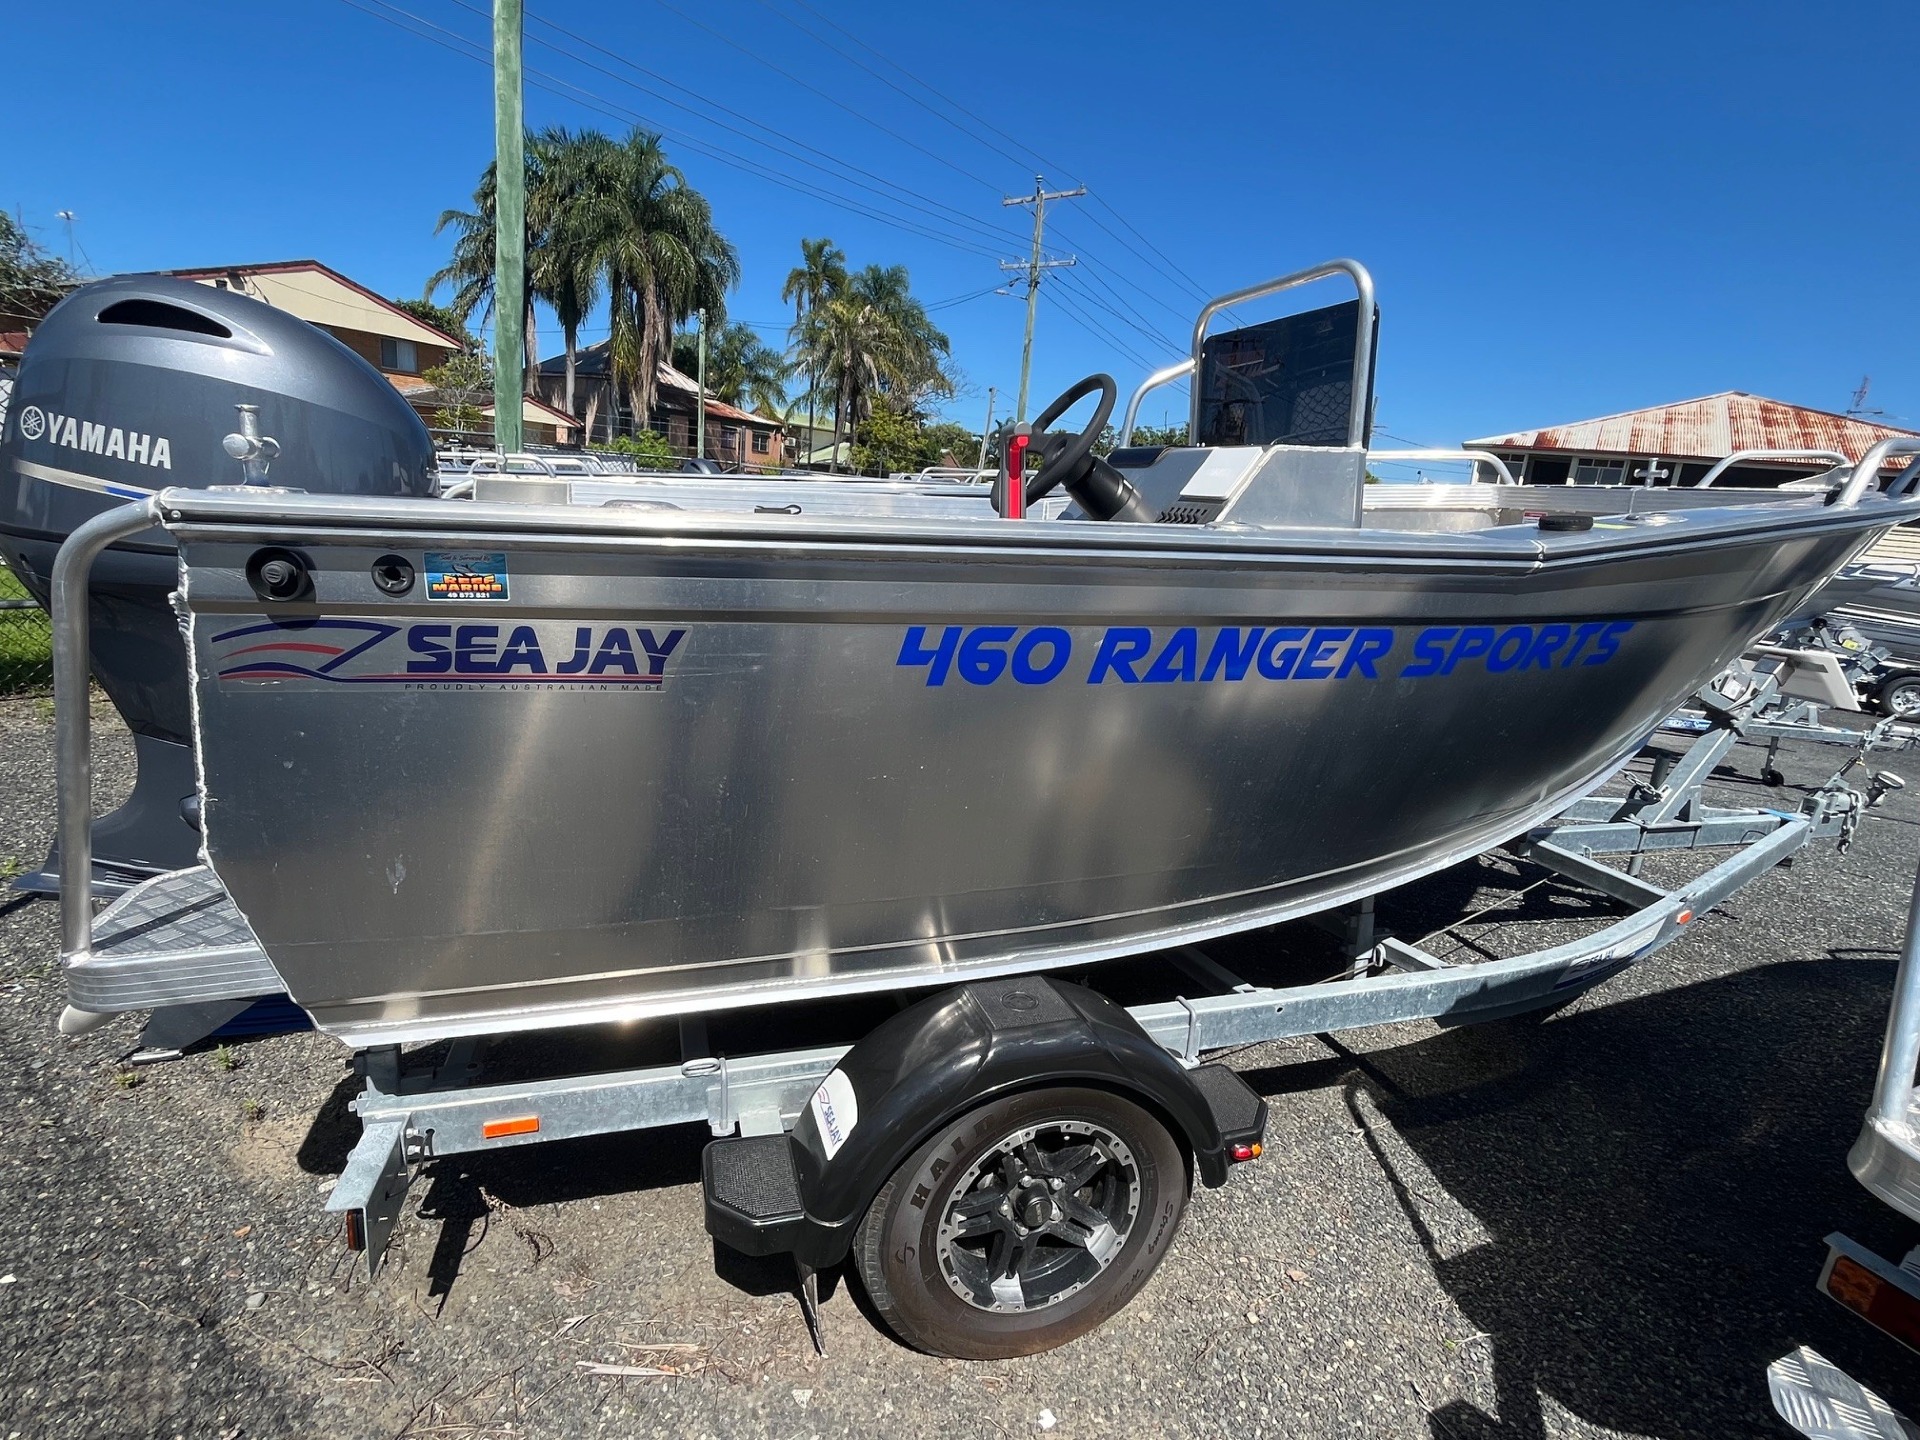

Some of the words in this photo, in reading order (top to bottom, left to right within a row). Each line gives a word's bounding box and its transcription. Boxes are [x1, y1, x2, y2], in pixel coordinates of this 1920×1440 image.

[48, 412, 172, 470] YAMAHA
[432, 583, 503, 592] MARINE
[443, 574, 496, 584] REEF
[406, 625, 546, 674] SEA
[556, 628, 687, 675] JAY
[896, 626, 1073, 687] 460
[1087, 626, 1396, 684] RANGER
[1401, 622, 1635, 679] SPORTS
[404, 683, 486, 691] PROUDLY
[499, 683, 608, 691] AUSTRALIAN
